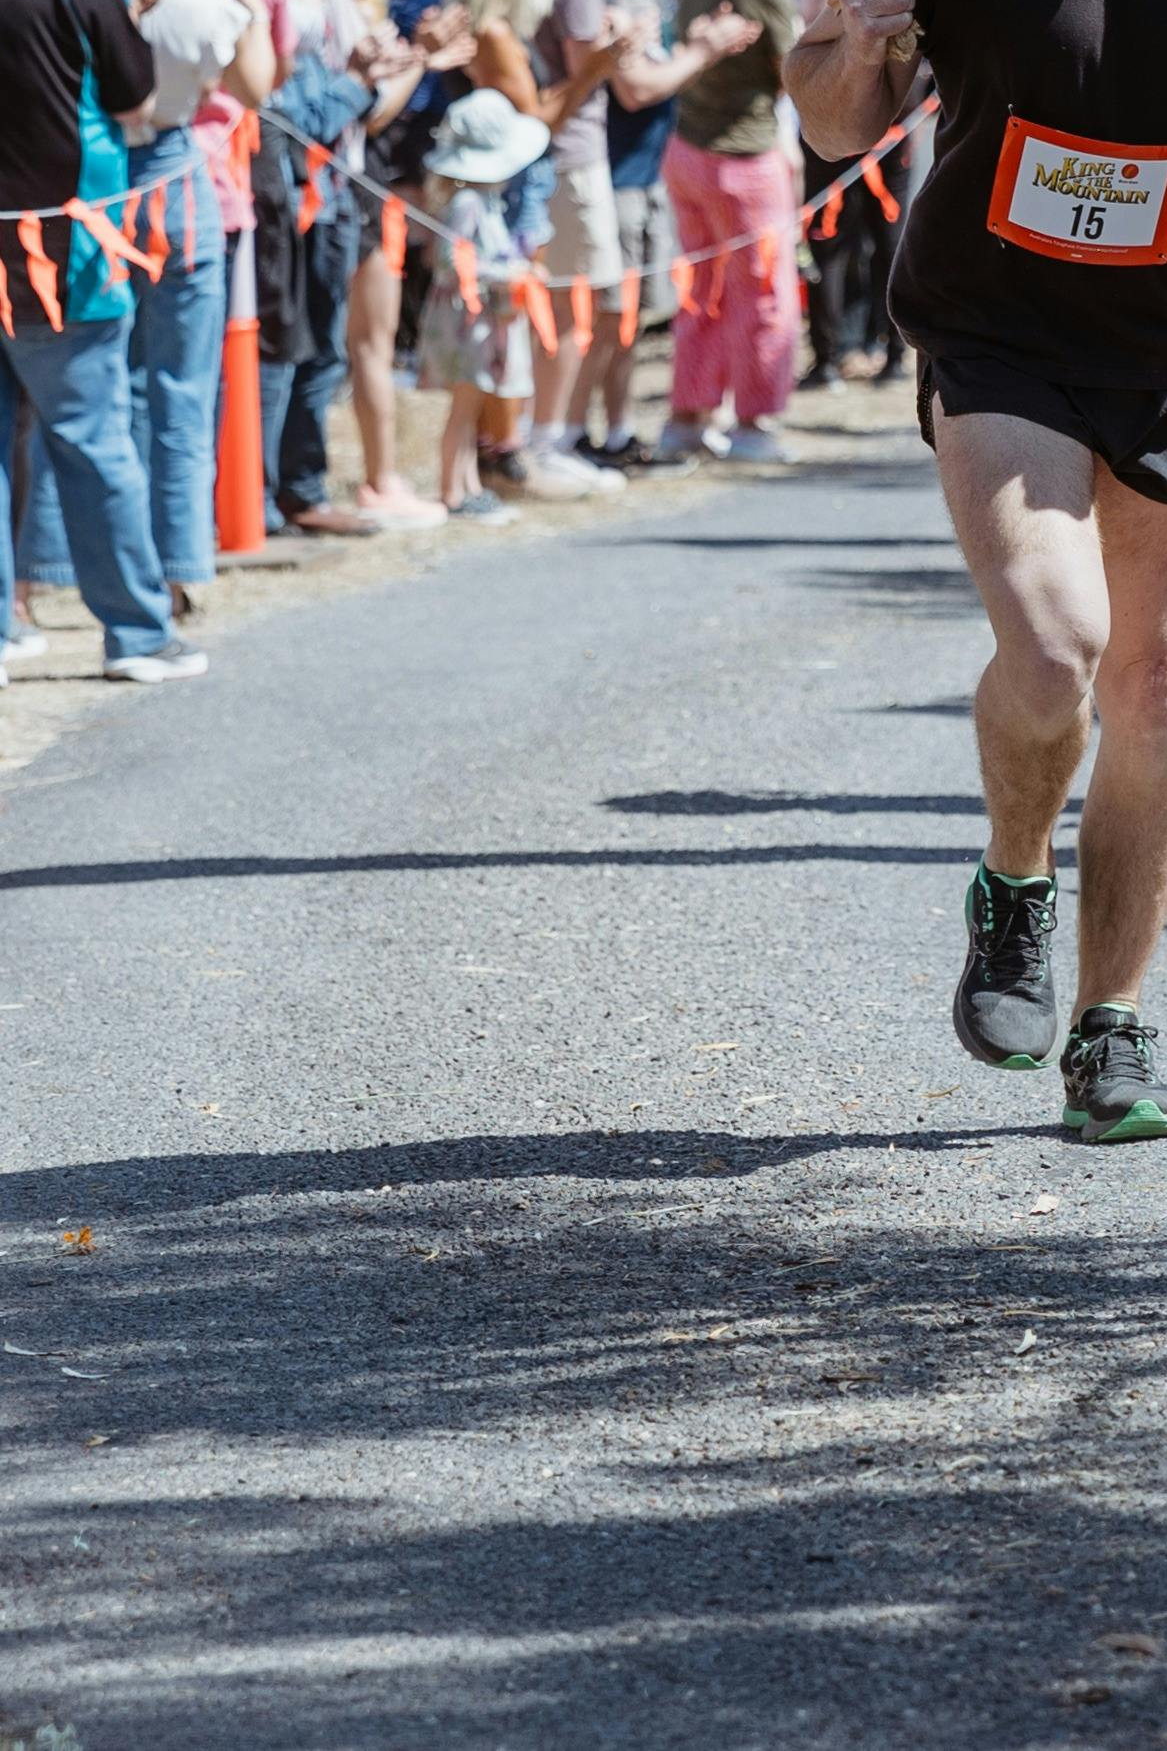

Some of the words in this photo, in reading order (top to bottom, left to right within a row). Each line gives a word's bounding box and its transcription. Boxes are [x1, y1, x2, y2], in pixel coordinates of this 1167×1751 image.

[1032, 163, 1150, 203] MOUNTAIN
[1060, 157, 1116, 181] KING
[1087, 176, 1114, 189] THE
[1070, 204, 1106, 239] 15
